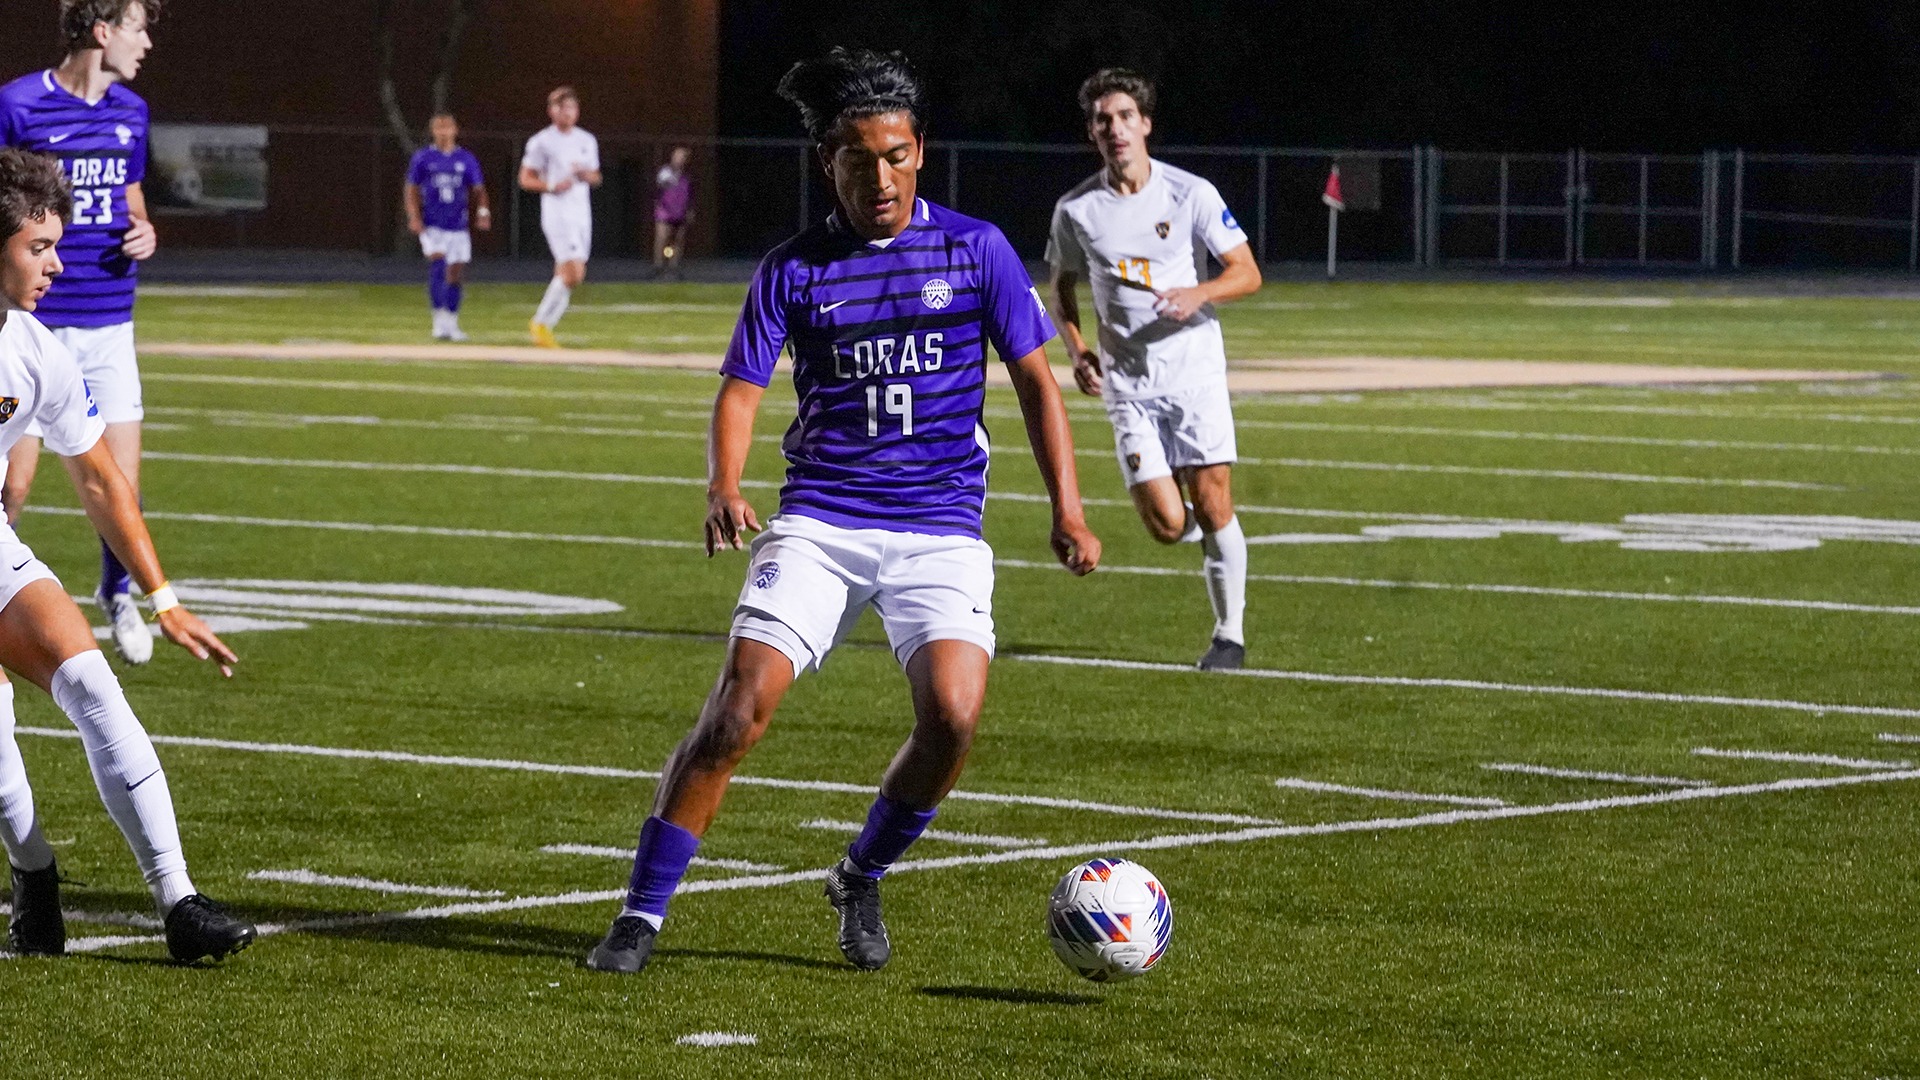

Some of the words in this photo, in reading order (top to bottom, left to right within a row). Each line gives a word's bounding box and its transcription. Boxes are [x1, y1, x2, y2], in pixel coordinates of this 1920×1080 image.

[72, 188, 112, 225] 23
[831, 332, 944, 379] LORAS
[865, 383, 913, 437] 19
